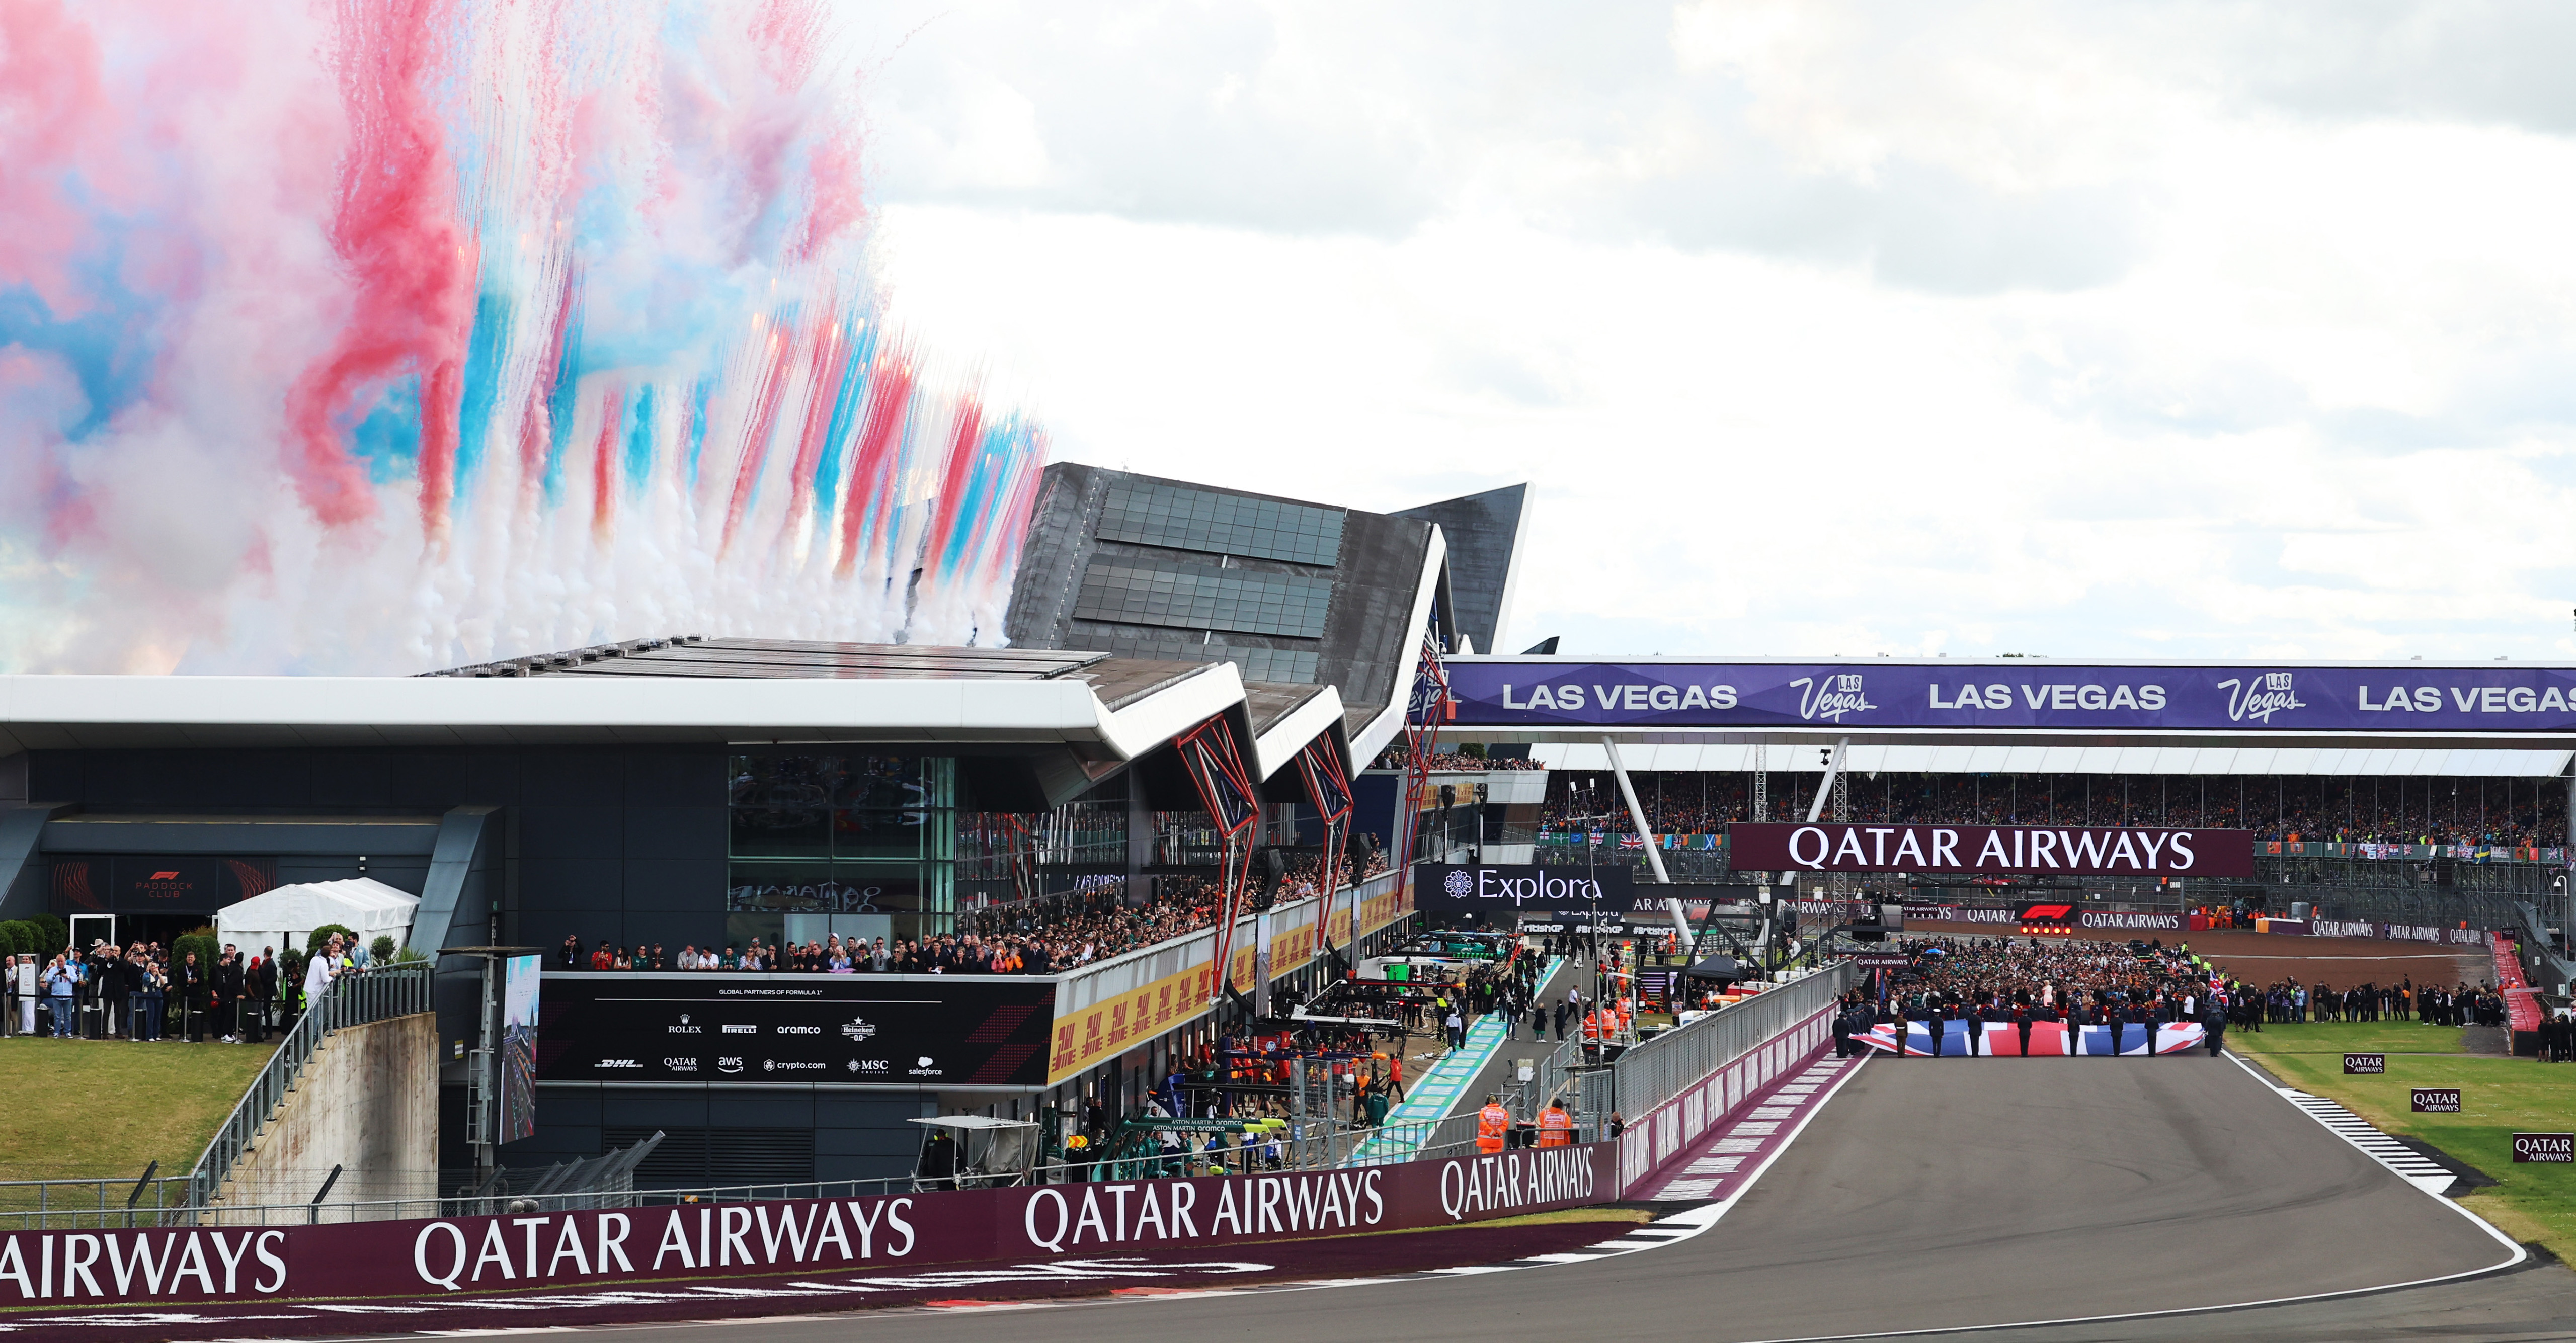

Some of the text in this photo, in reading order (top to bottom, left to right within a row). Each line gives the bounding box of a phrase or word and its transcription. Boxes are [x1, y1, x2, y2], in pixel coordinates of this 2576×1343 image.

[1838, 676, 1861, 692] LAS
[2267, 675, 2290, 689] LAS
[1503, 684, 1738, 710] LAS VEGAS
[1790, 675, 1877, 723] Vegas
[1930, 684, 2166, 710] LAS VEGAS
[2217, 676, 2306, 724] Vegas
[2359, 686, 2442, 712] LAS
[1789, 827, 2194, 869] QATAR AIRWAYS
[1480, 870, 1603, 906] Explora
[1968, 909, 2006, 922] QATAR
[2082, 913, 2179, 928] QATAR AIRWAYS
[2313, 920, 2373, 937] QATAR AIRWAYS
[2412, 926, 2440, 941] AIRWAYS
[2450, 929, 2468, 943] QATAR
[722, 1025, 757, 1034] PIRELLI
[777, 1026, 821, 1034] aramco
[601, 1059, 637, 1067] DHL
[664, 1058, 697, 1067] QATAR
[719, 1057, 742, 1065] aws
[777, 1061, 825, 1072] crypto.com
[861, 1060, 888, 1069] MSC
[2345, 1057, 2382, 1067] QATAR
[909, 1068, 942, 1076] salesforce
[2413, 1093, 2458, 1105] QATAR
[2516, 1139, 2571, 1154] QATAR
[2529, 1152, 2571, 1162] AIRWAYS
[1441, 1146, 1593, 1220] QATAR AIRWAYS
[1025, 1170, 1383, 1253] QATAR AIRWAYS
[415, 1198, 915, 1291] QATAR AIRWAYS
[0, 1231, 285, 1298] AIRWAYS
